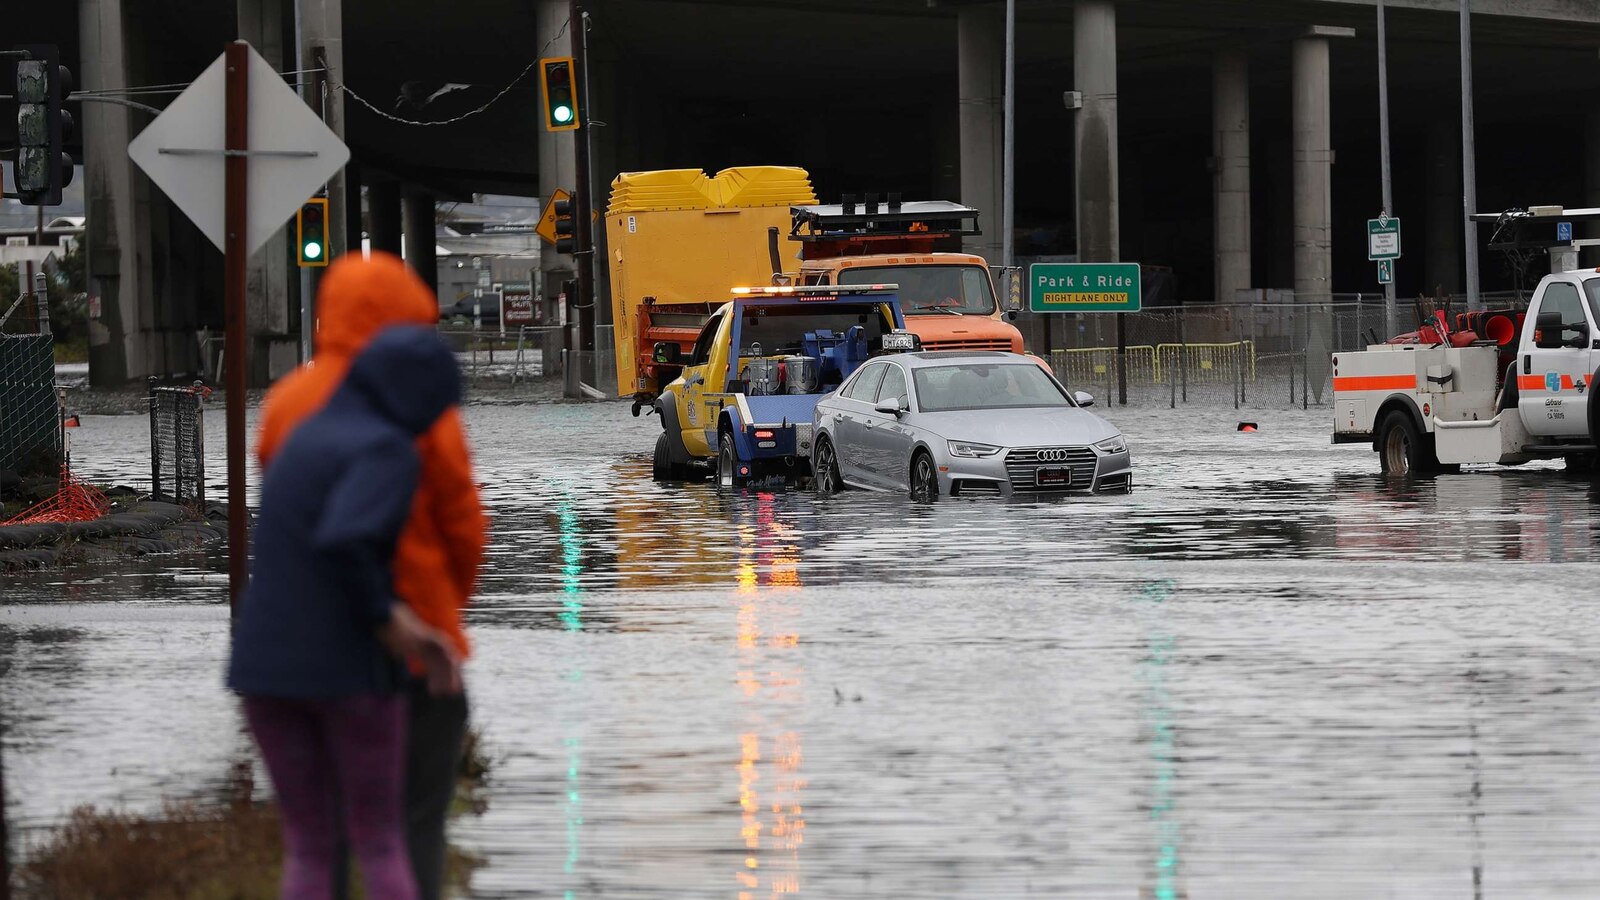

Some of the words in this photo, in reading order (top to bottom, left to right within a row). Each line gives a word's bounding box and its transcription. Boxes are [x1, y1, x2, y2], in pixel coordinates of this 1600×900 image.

[1038, 275, 1074, 287] Park
[1082, 275, 1090, 287] &
[1097, 275, 1132, 287] Ride
[1045, 294, 1072, 302] RIGHT
[1075, 294, 1100, 302] LANE
[1103, 294, 1126, 302] ONLY
